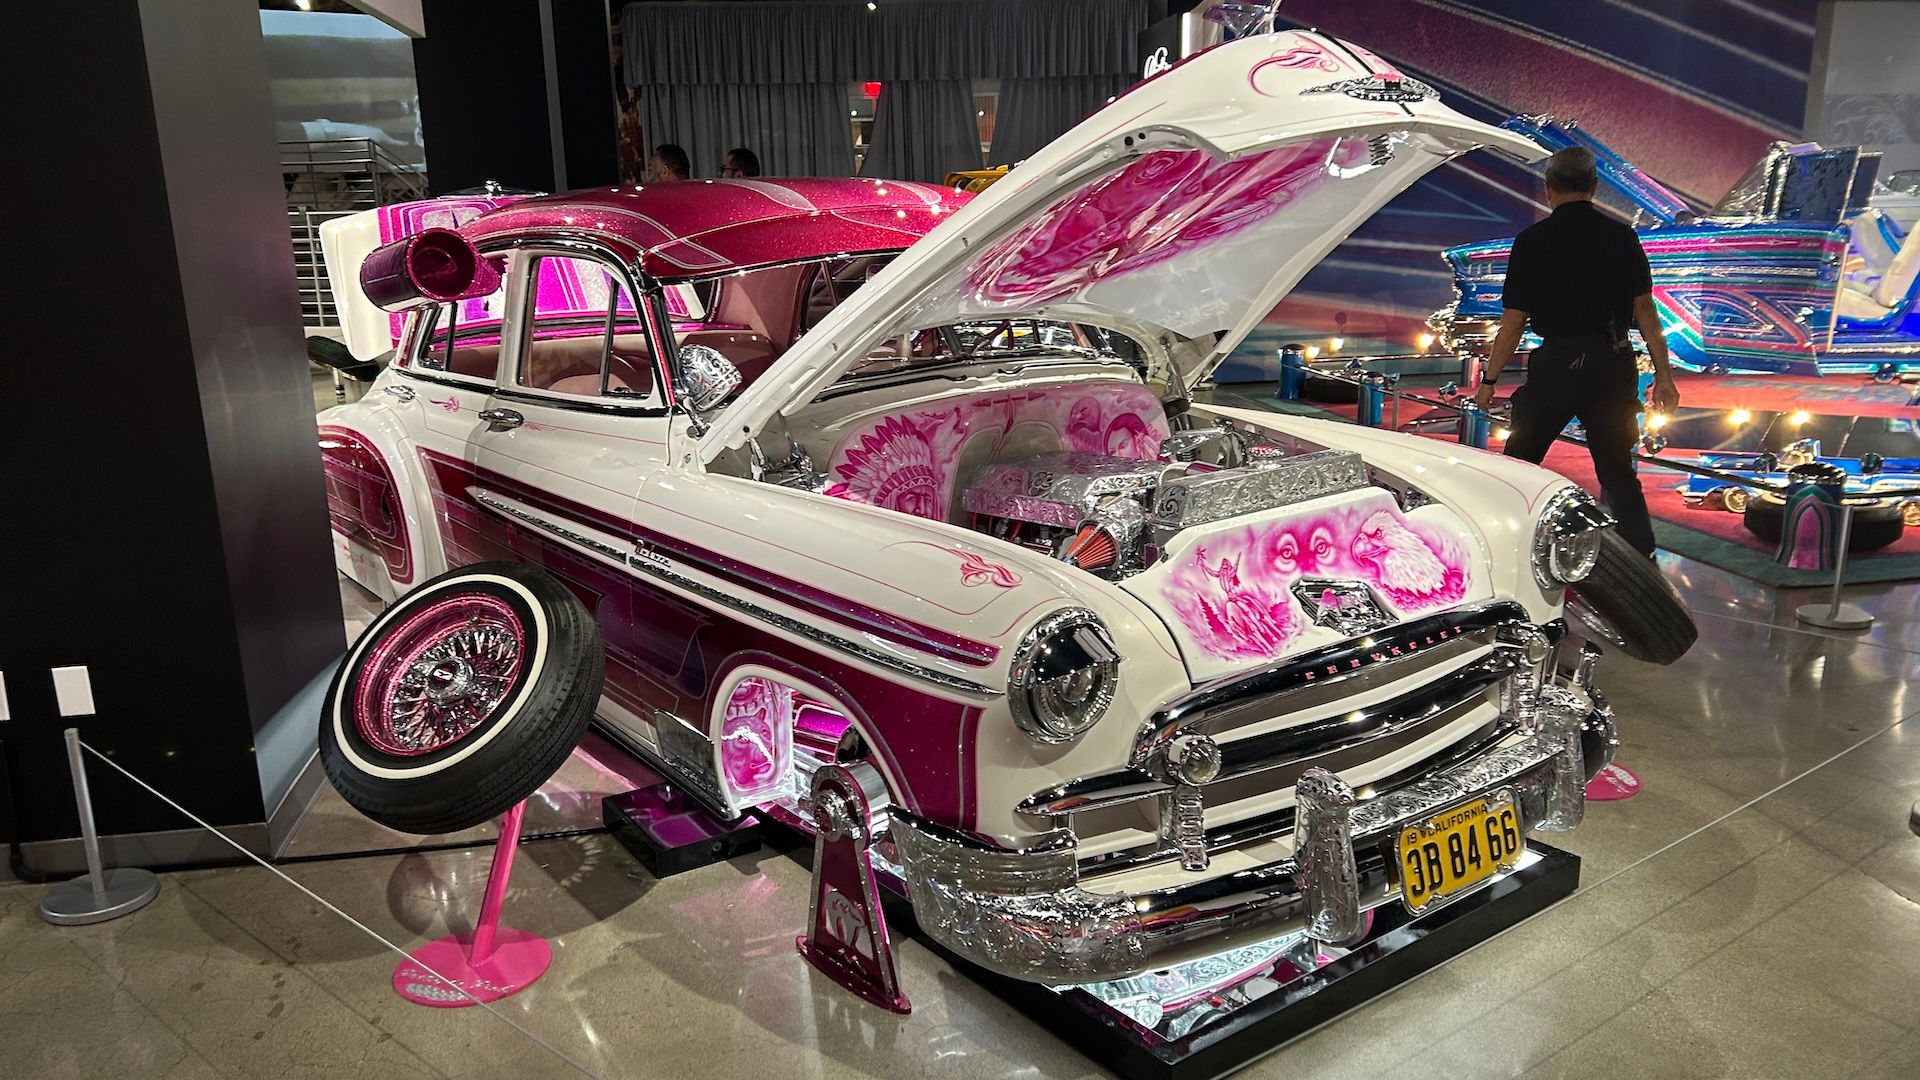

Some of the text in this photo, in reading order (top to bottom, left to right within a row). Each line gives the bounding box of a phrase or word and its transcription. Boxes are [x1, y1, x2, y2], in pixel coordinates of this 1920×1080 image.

[1406, 809, 1517, 897] 3B 84 66
